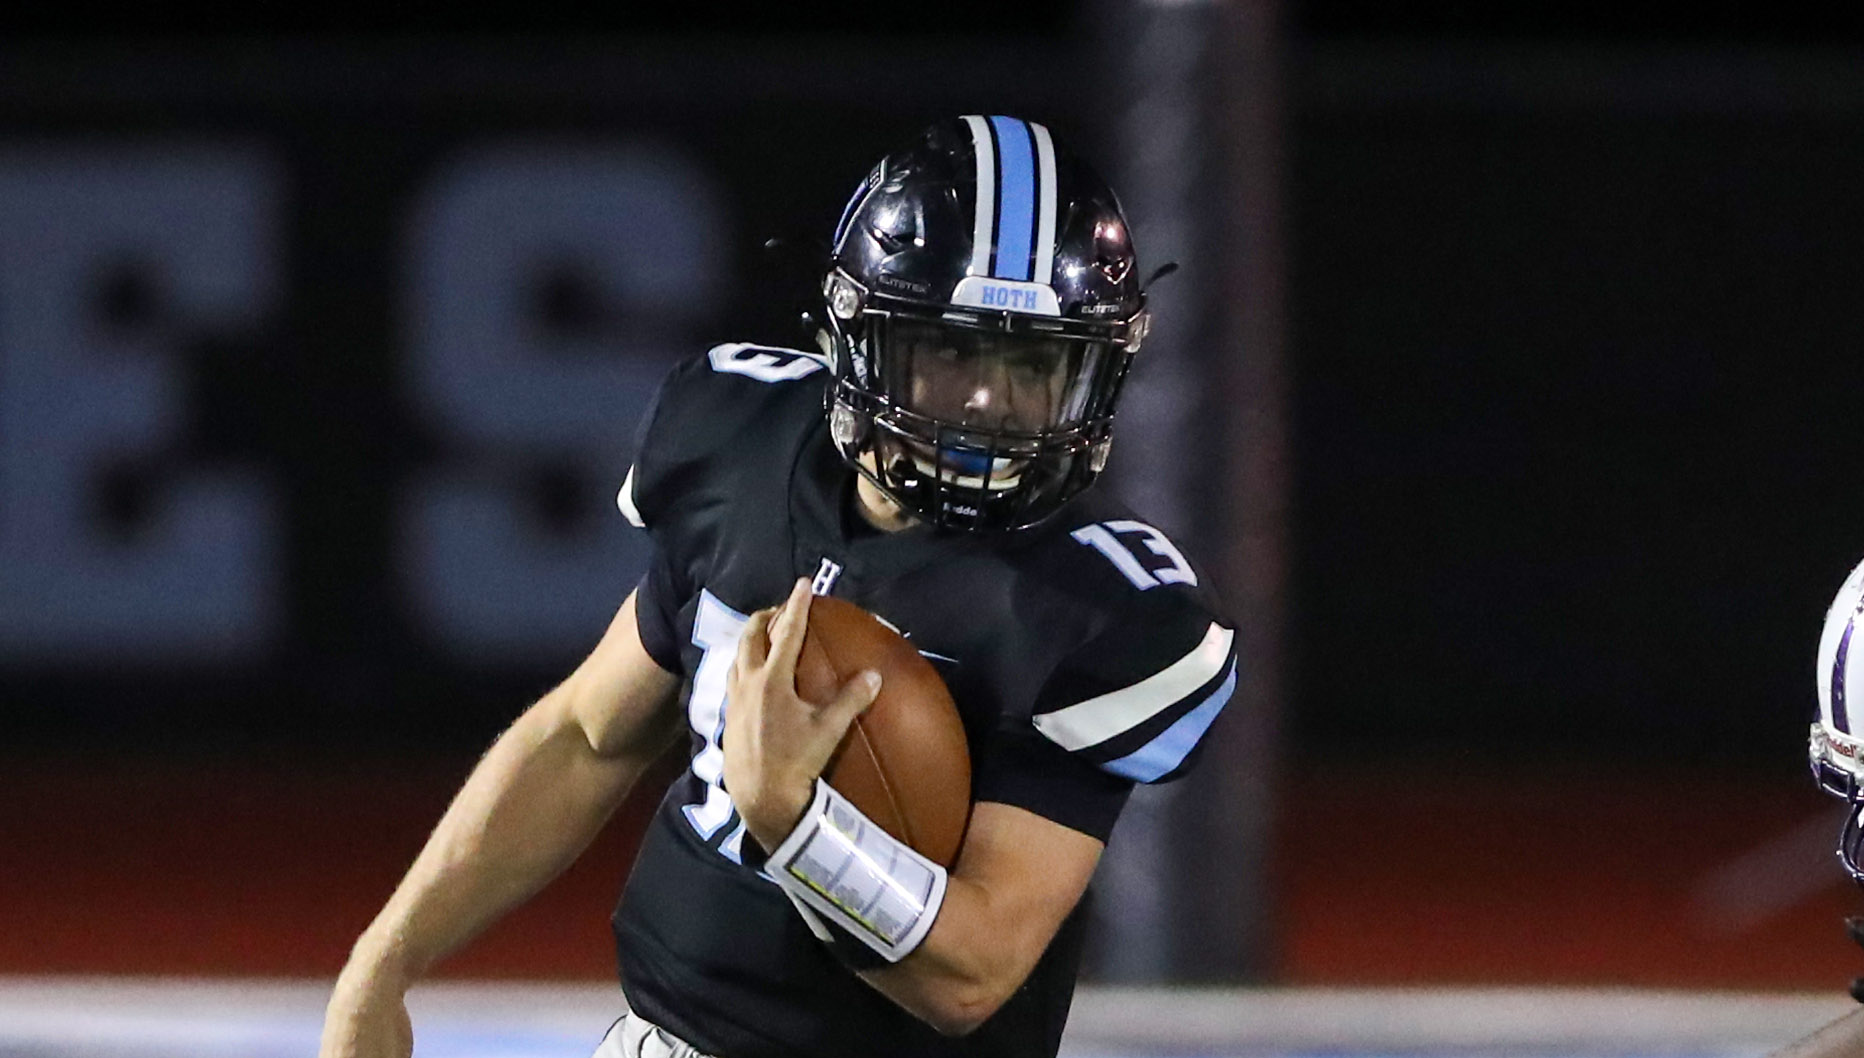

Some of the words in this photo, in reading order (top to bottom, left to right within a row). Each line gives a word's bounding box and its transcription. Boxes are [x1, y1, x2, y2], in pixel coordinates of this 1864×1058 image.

[981, 285, 1039, 310] HOTH
[1069, 520, 1198, 591] 13
[812, 559, 843, 596] H
